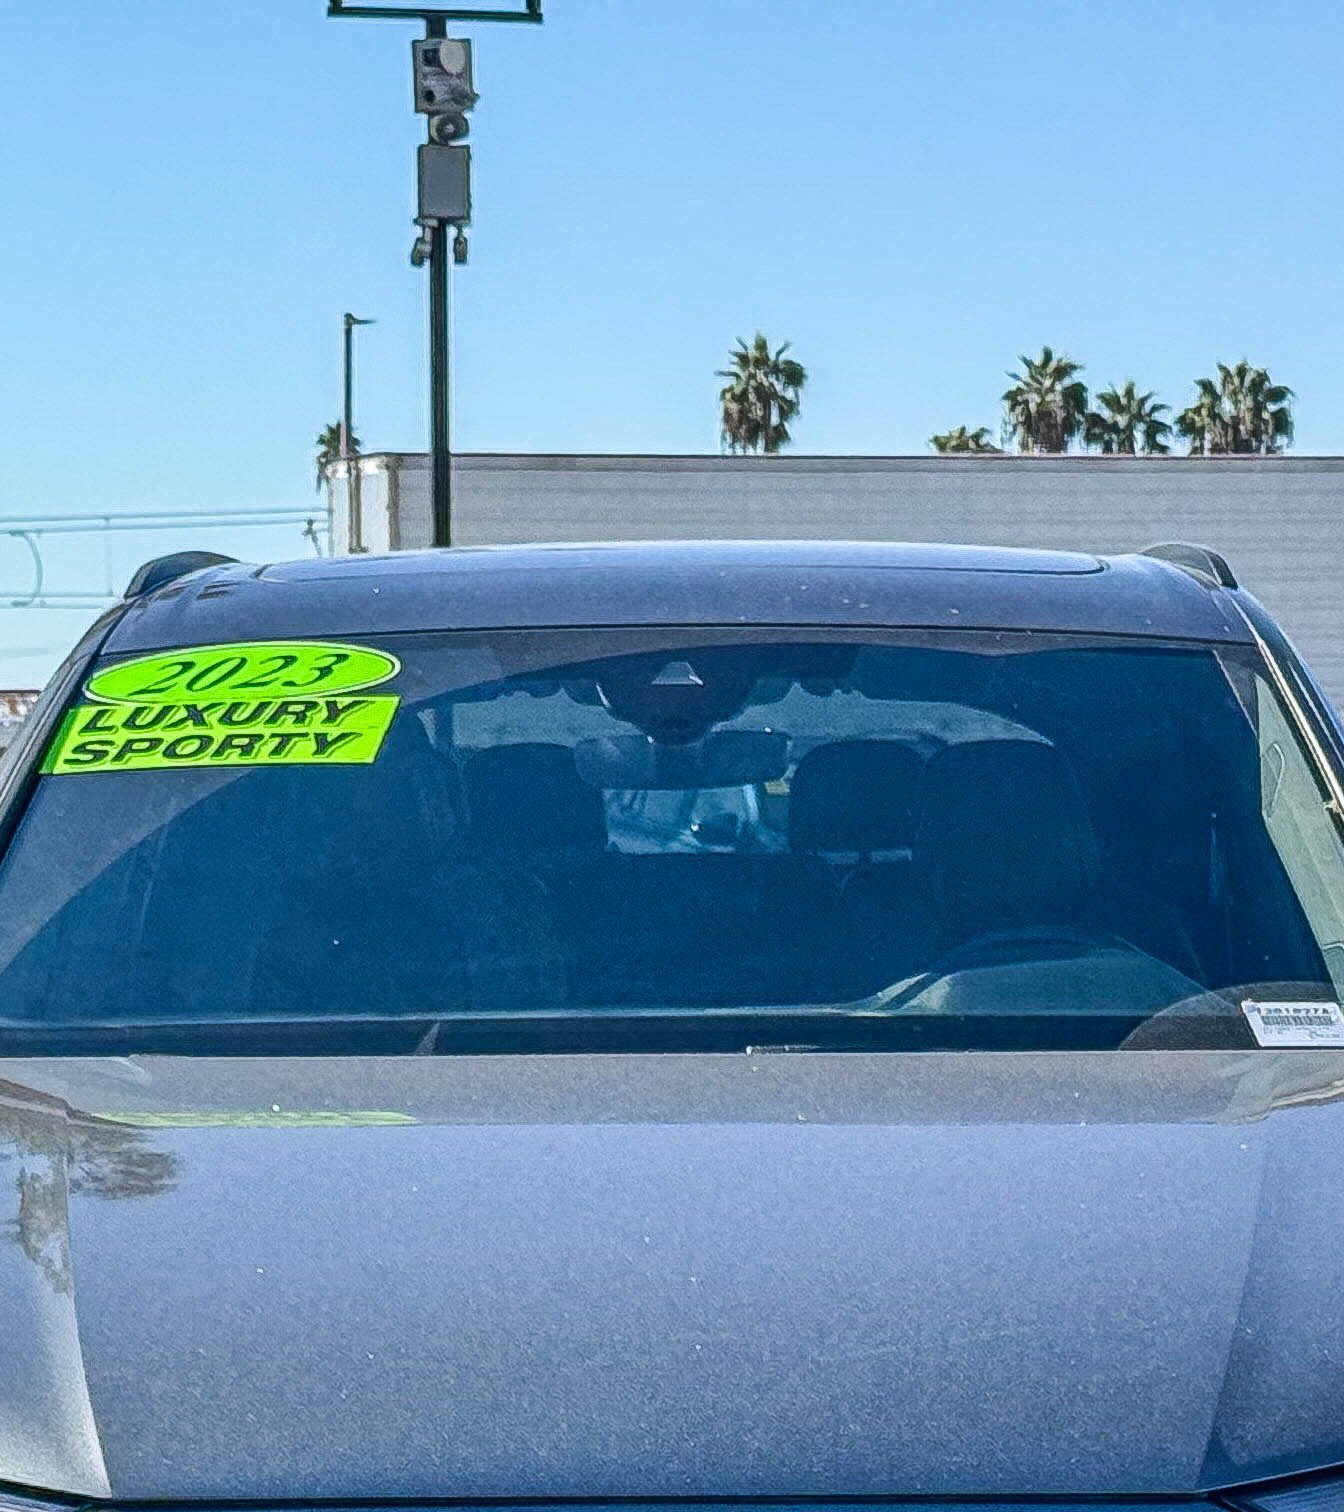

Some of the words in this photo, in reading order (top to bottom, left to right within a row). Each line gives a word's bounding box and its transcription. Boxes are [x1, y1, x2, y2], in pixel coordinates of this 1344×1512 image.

[128, 653, 350, 696] 2023
[79, 700, 371, 737] LUXURY
[63, 731, 364, 766] SPORTY
